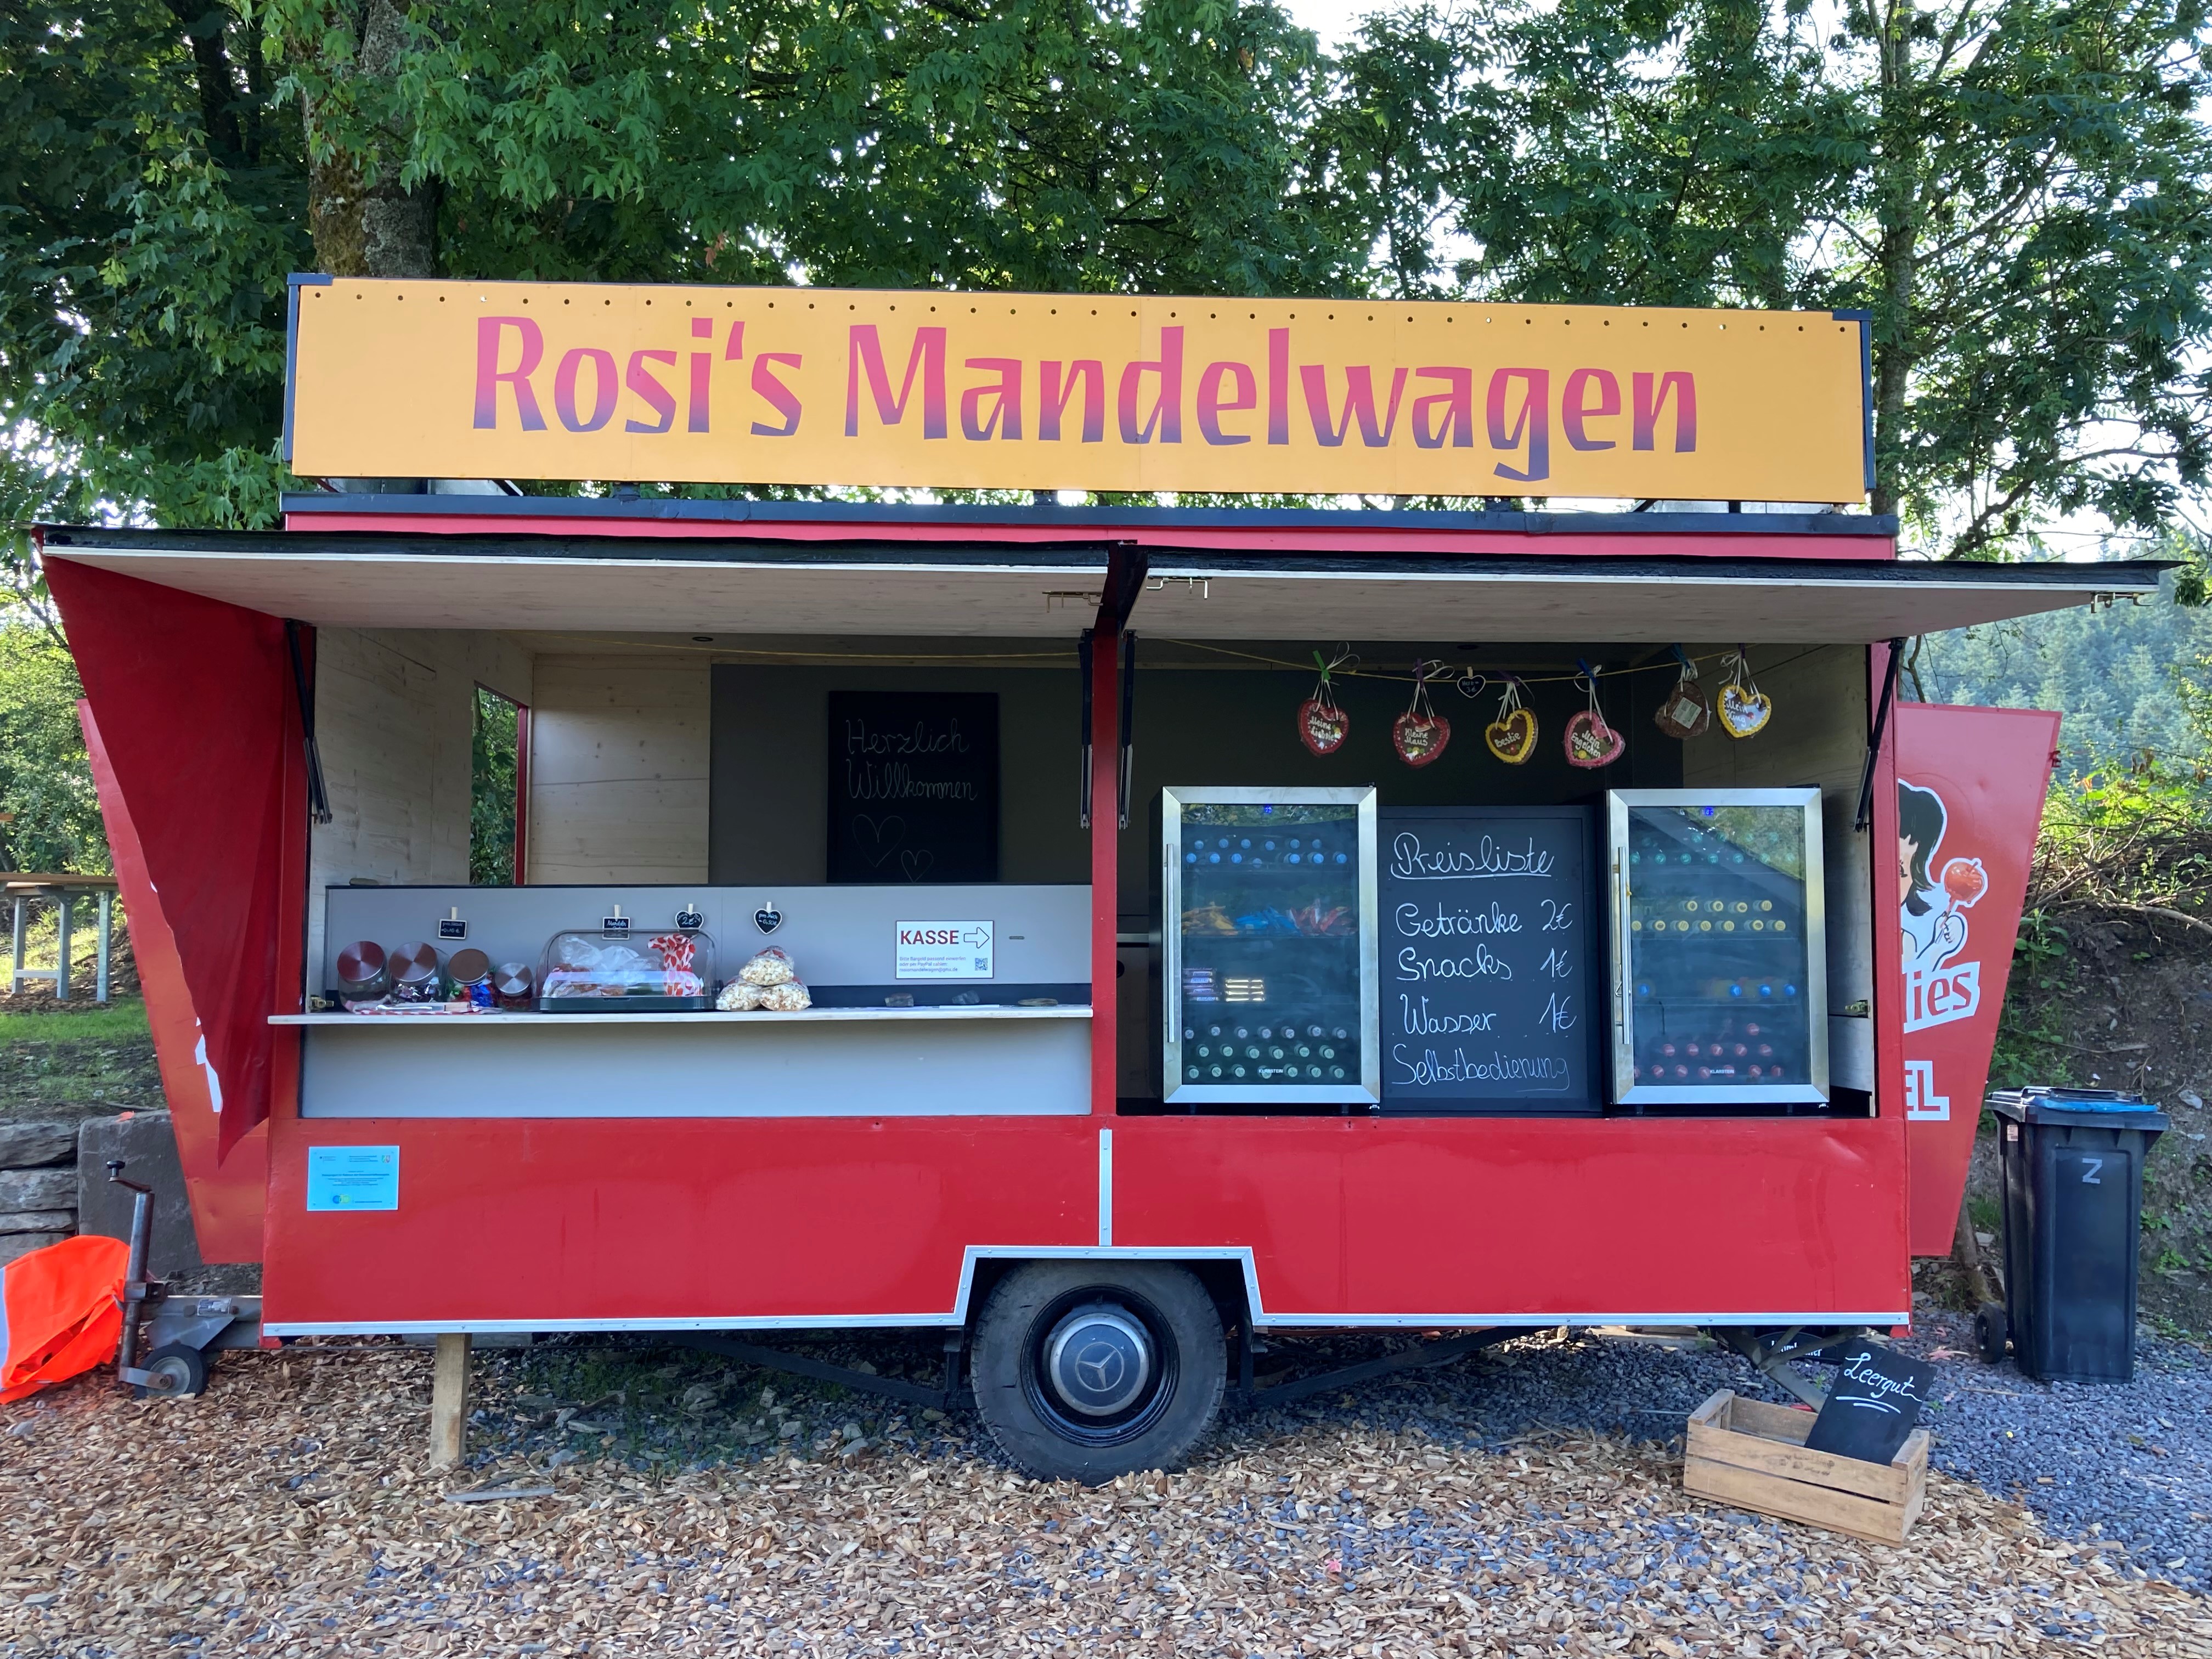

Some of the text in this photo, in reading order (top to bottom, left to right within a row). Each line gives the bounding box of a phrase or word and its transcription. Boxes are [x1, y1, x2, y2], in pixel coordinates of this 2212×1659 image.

[473, 317, 1697, 482] Rosi's Mandelwagen
[1309, 715, 1331, 730] Meine
[1725, 699, 1748, 714] Mein
[845, 718, 969, 754] Herzlich
[1404, 727, 1429, 739] Kleine
[1404, 736, 1428, 746] Maus
[1571, 732, 1601, 758] Engelchen
[1582, 730, 1600, 749] Mein
[845, 759, 978, 800] Willkommen
[1391, 832, 1555, 877] Preisliste
[1395, 899, 1573, 937] Getränke 2€
[901, 930, 959, 945] KASSE
[1396, 943, 1573, 980] Snacks 1€
[1400, 992, 1577, 1035] Wasser 1€
[1391, 1043, 1570, 1091] Selbstbedienung
[1843, 1352, 1923, 1402] Leergut
